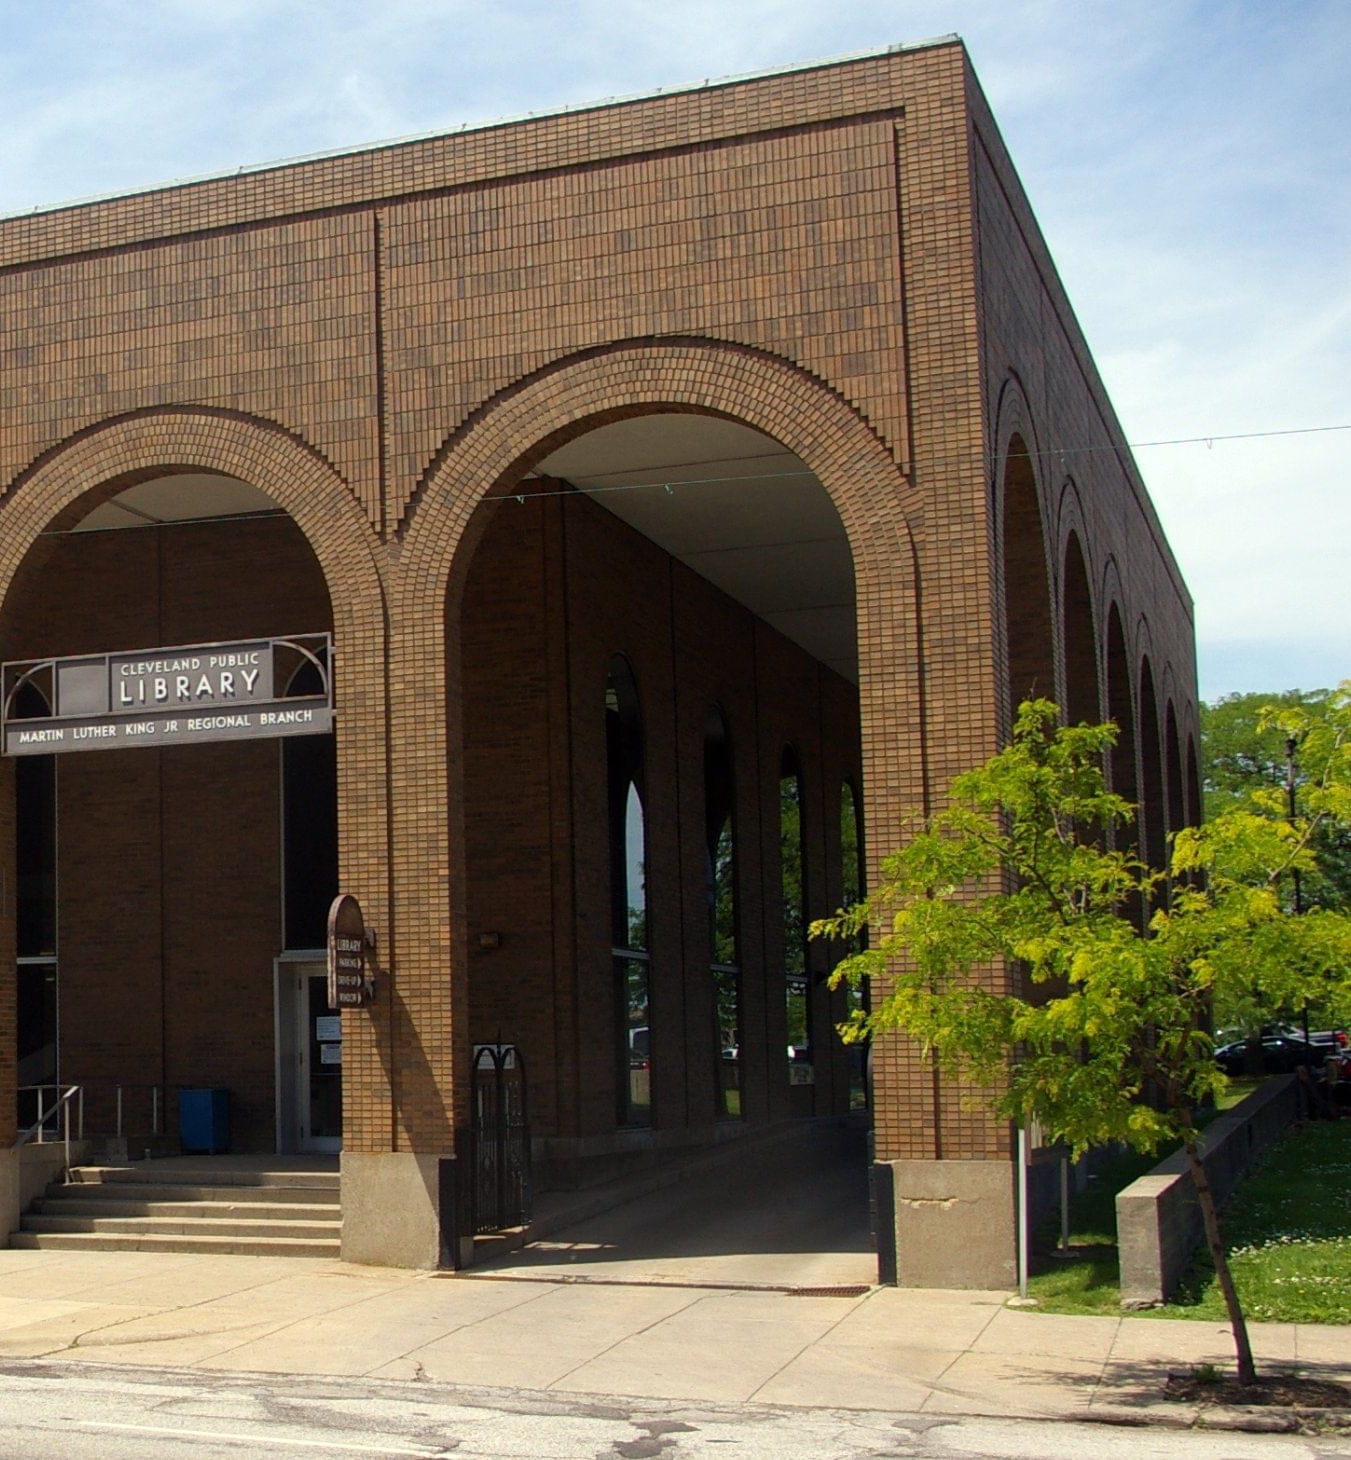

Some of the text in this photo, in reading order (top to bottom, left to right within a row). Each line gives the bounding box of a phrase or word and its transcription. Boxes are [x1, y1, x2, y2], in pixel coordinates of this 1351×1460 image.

[121, 652, 259, 676] CLEVELAND PUBLIC
[120, 669, 258, 702] LIBRARY
[19, 709, 313, 743] MARTIN LUTHER KING JR REGIONAL BRANCH
[337, 939, 361, 952] LIBRARY
